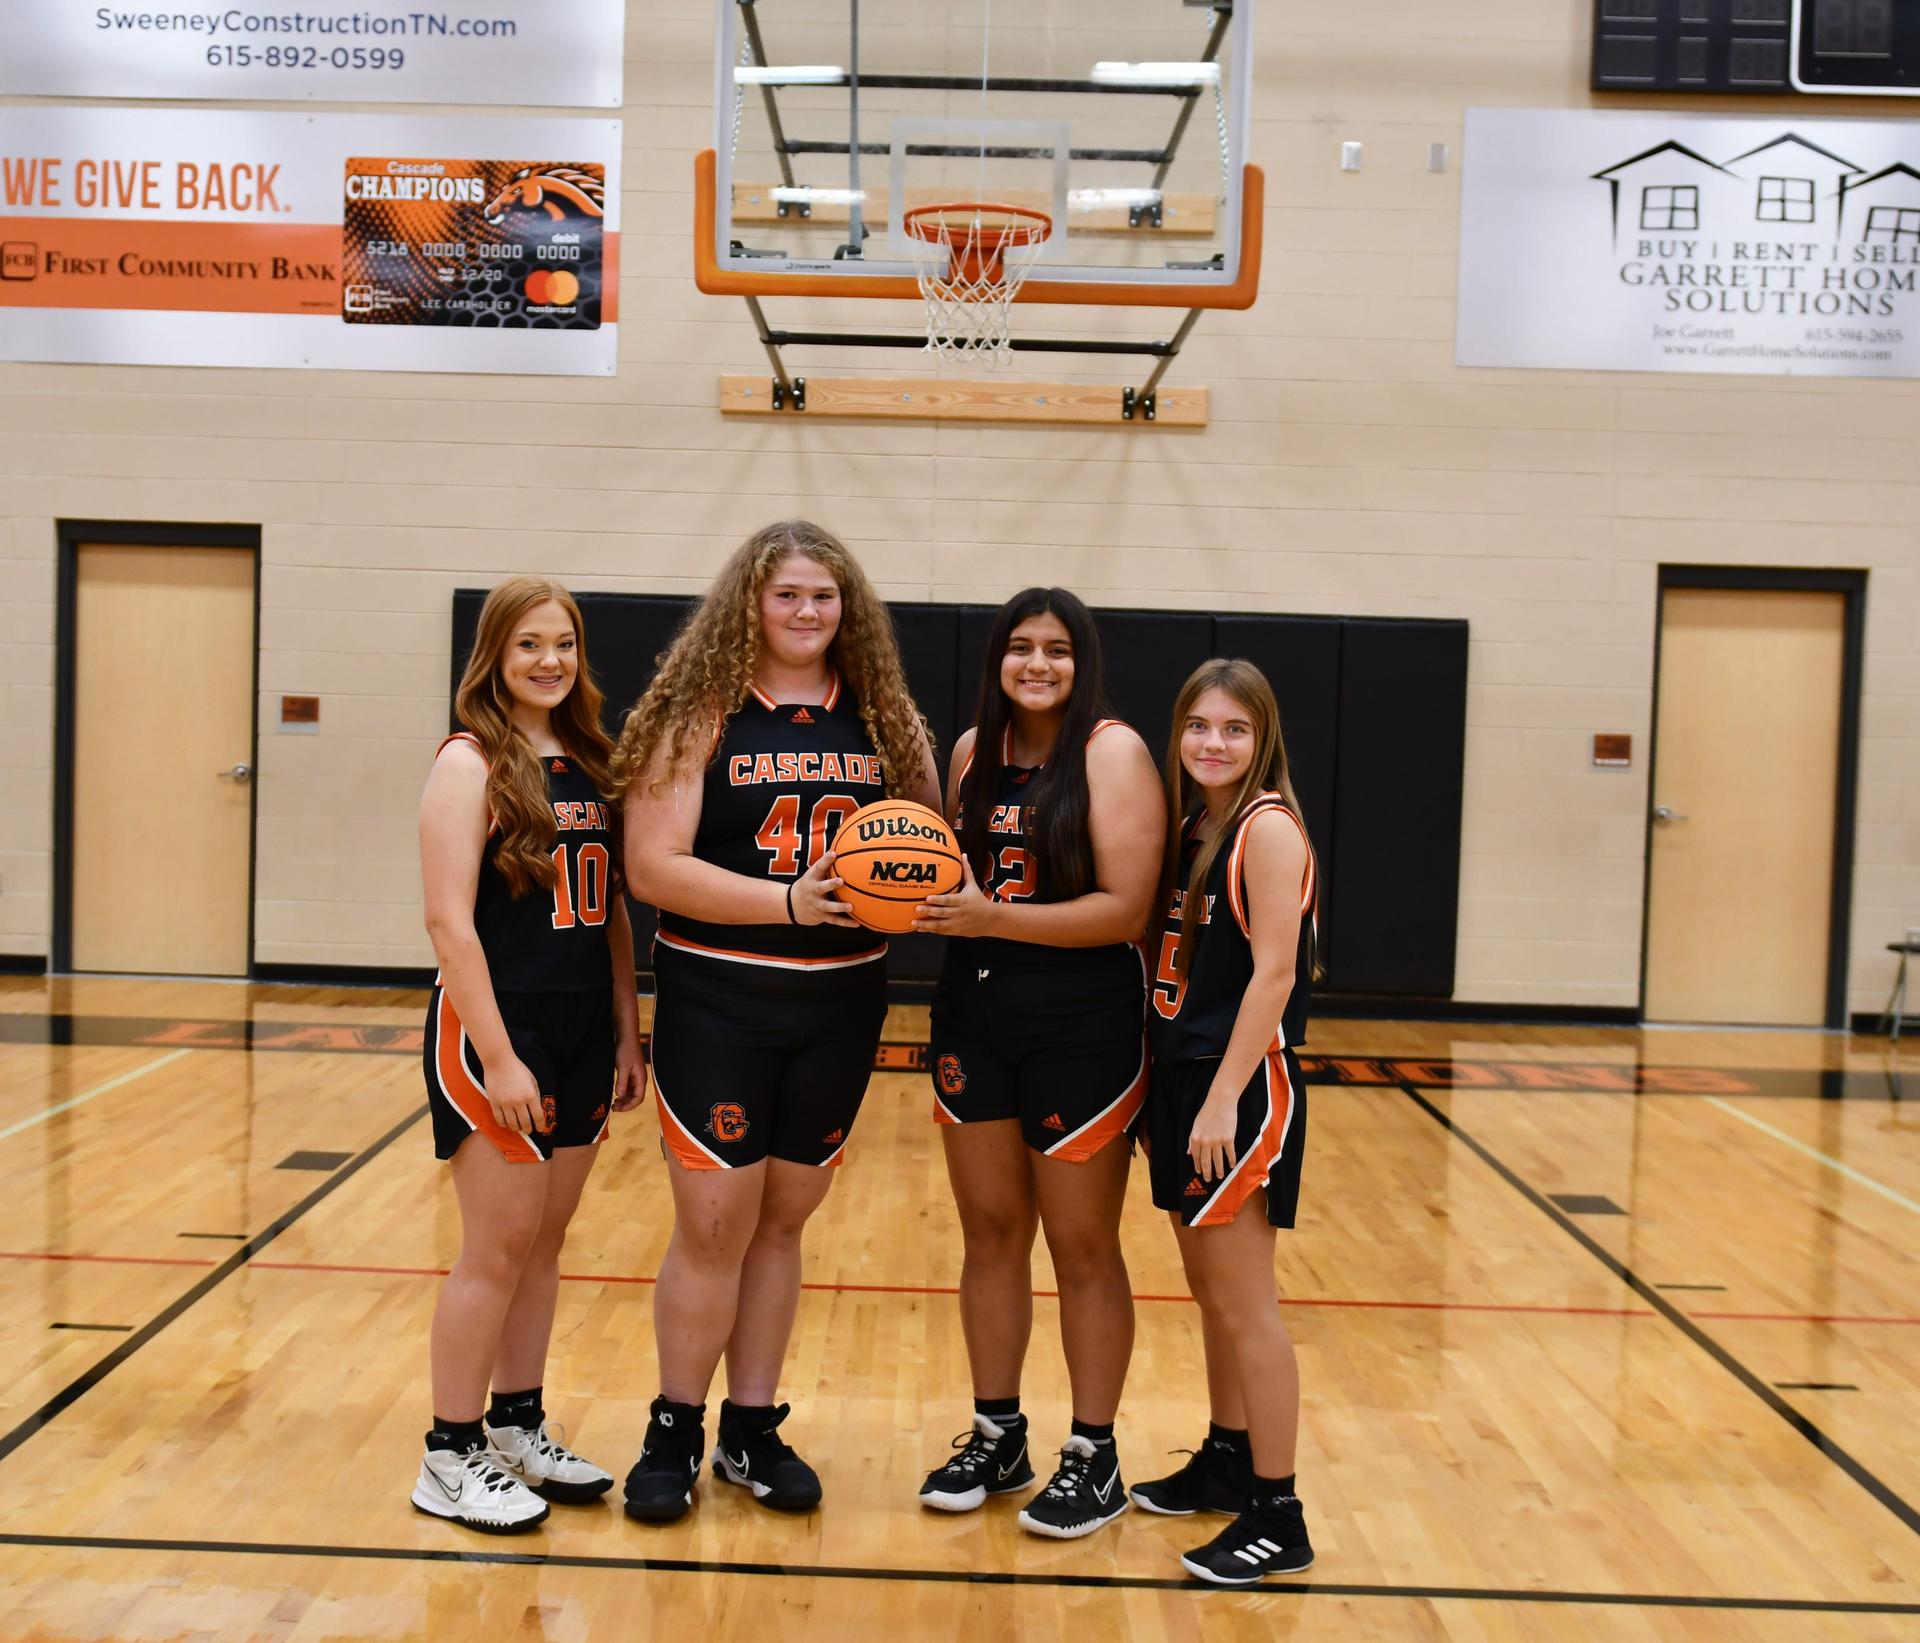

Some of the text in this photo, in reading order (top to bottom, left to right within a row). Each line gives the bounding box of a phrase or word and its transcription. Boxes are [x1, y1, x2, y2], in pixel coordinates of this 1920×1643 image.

[96, 8, 517, 36] SweeneyConstructionTN.com
[206, 45, 404, 69] 615-892-0599
[387, 161, 445, 174] Cascade
[2, 158, 292, 212] WE GIVE BACK.
[345, 175, 486, 202] CHAMPIONS
[422, 242, 466, 257] 0000
[479, 244, 523, 259] 0000
[536, 245, 580, 260] 0000
[551, 232, 580, 244] debit
[1637, 239, 1698, 258] BUY
[1733, 241, 1818, 261] RENT
[45, 251, 336, 281] FIRST COMMUNITY BANK
[1620, 262, 1804, 289] GARRETT
[526, 305, 577, 315] mastercard
[1664, 289, 1894, 316] SOLUTIONS
[729, 752, 882, 786] CASCADE
[754, 794, 862, 876] 40
[857, 816, 948, 848] Wilson
[869, 860, 937, 884] NCAA
[551, 842, 609, 930] 10
